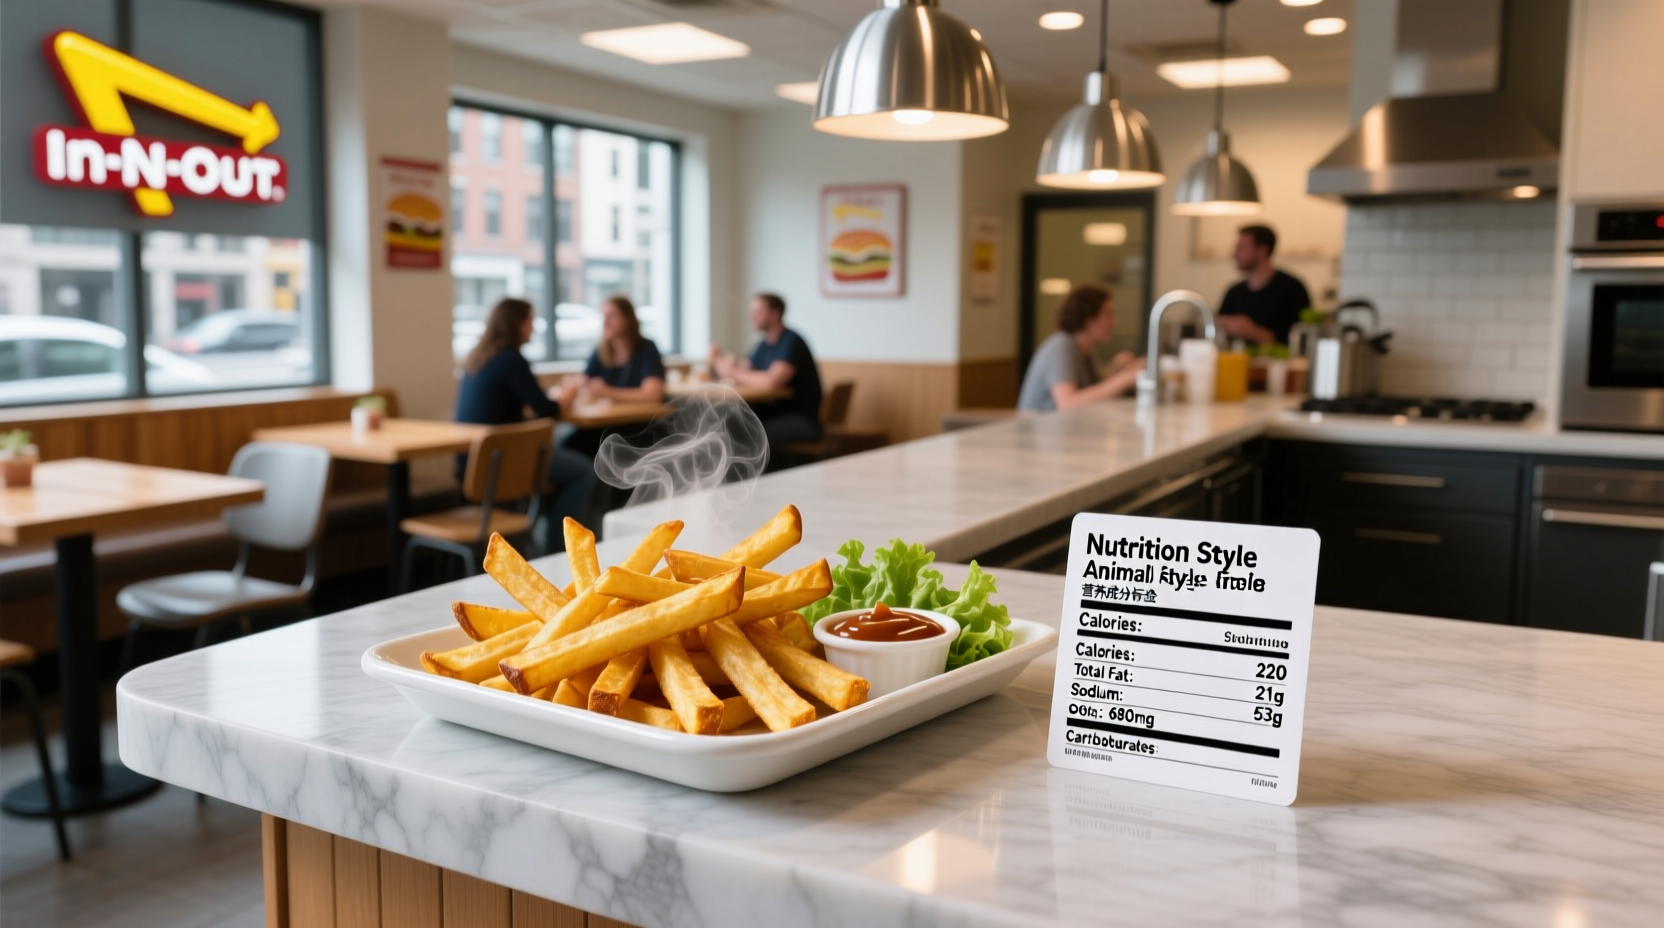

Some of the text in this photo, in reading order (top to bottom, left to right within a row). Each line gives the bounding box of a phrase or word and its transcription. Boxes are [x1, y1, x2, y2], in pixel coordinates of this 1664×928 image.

[1086, 532, 1258, 573] Nutrition Style
[1079, 612, 1142, 632] Calories:
[1075, 642, 1135, 661] Calories:
[1074, 662, 1133, 682] Total Fat:
[1255, 662, 1287, 681] 220
[1255, 685, 1285, 706] 21g
[1108, 706, 1155, 729] 680mg
[1253, 706, 1283, 728] 53g
